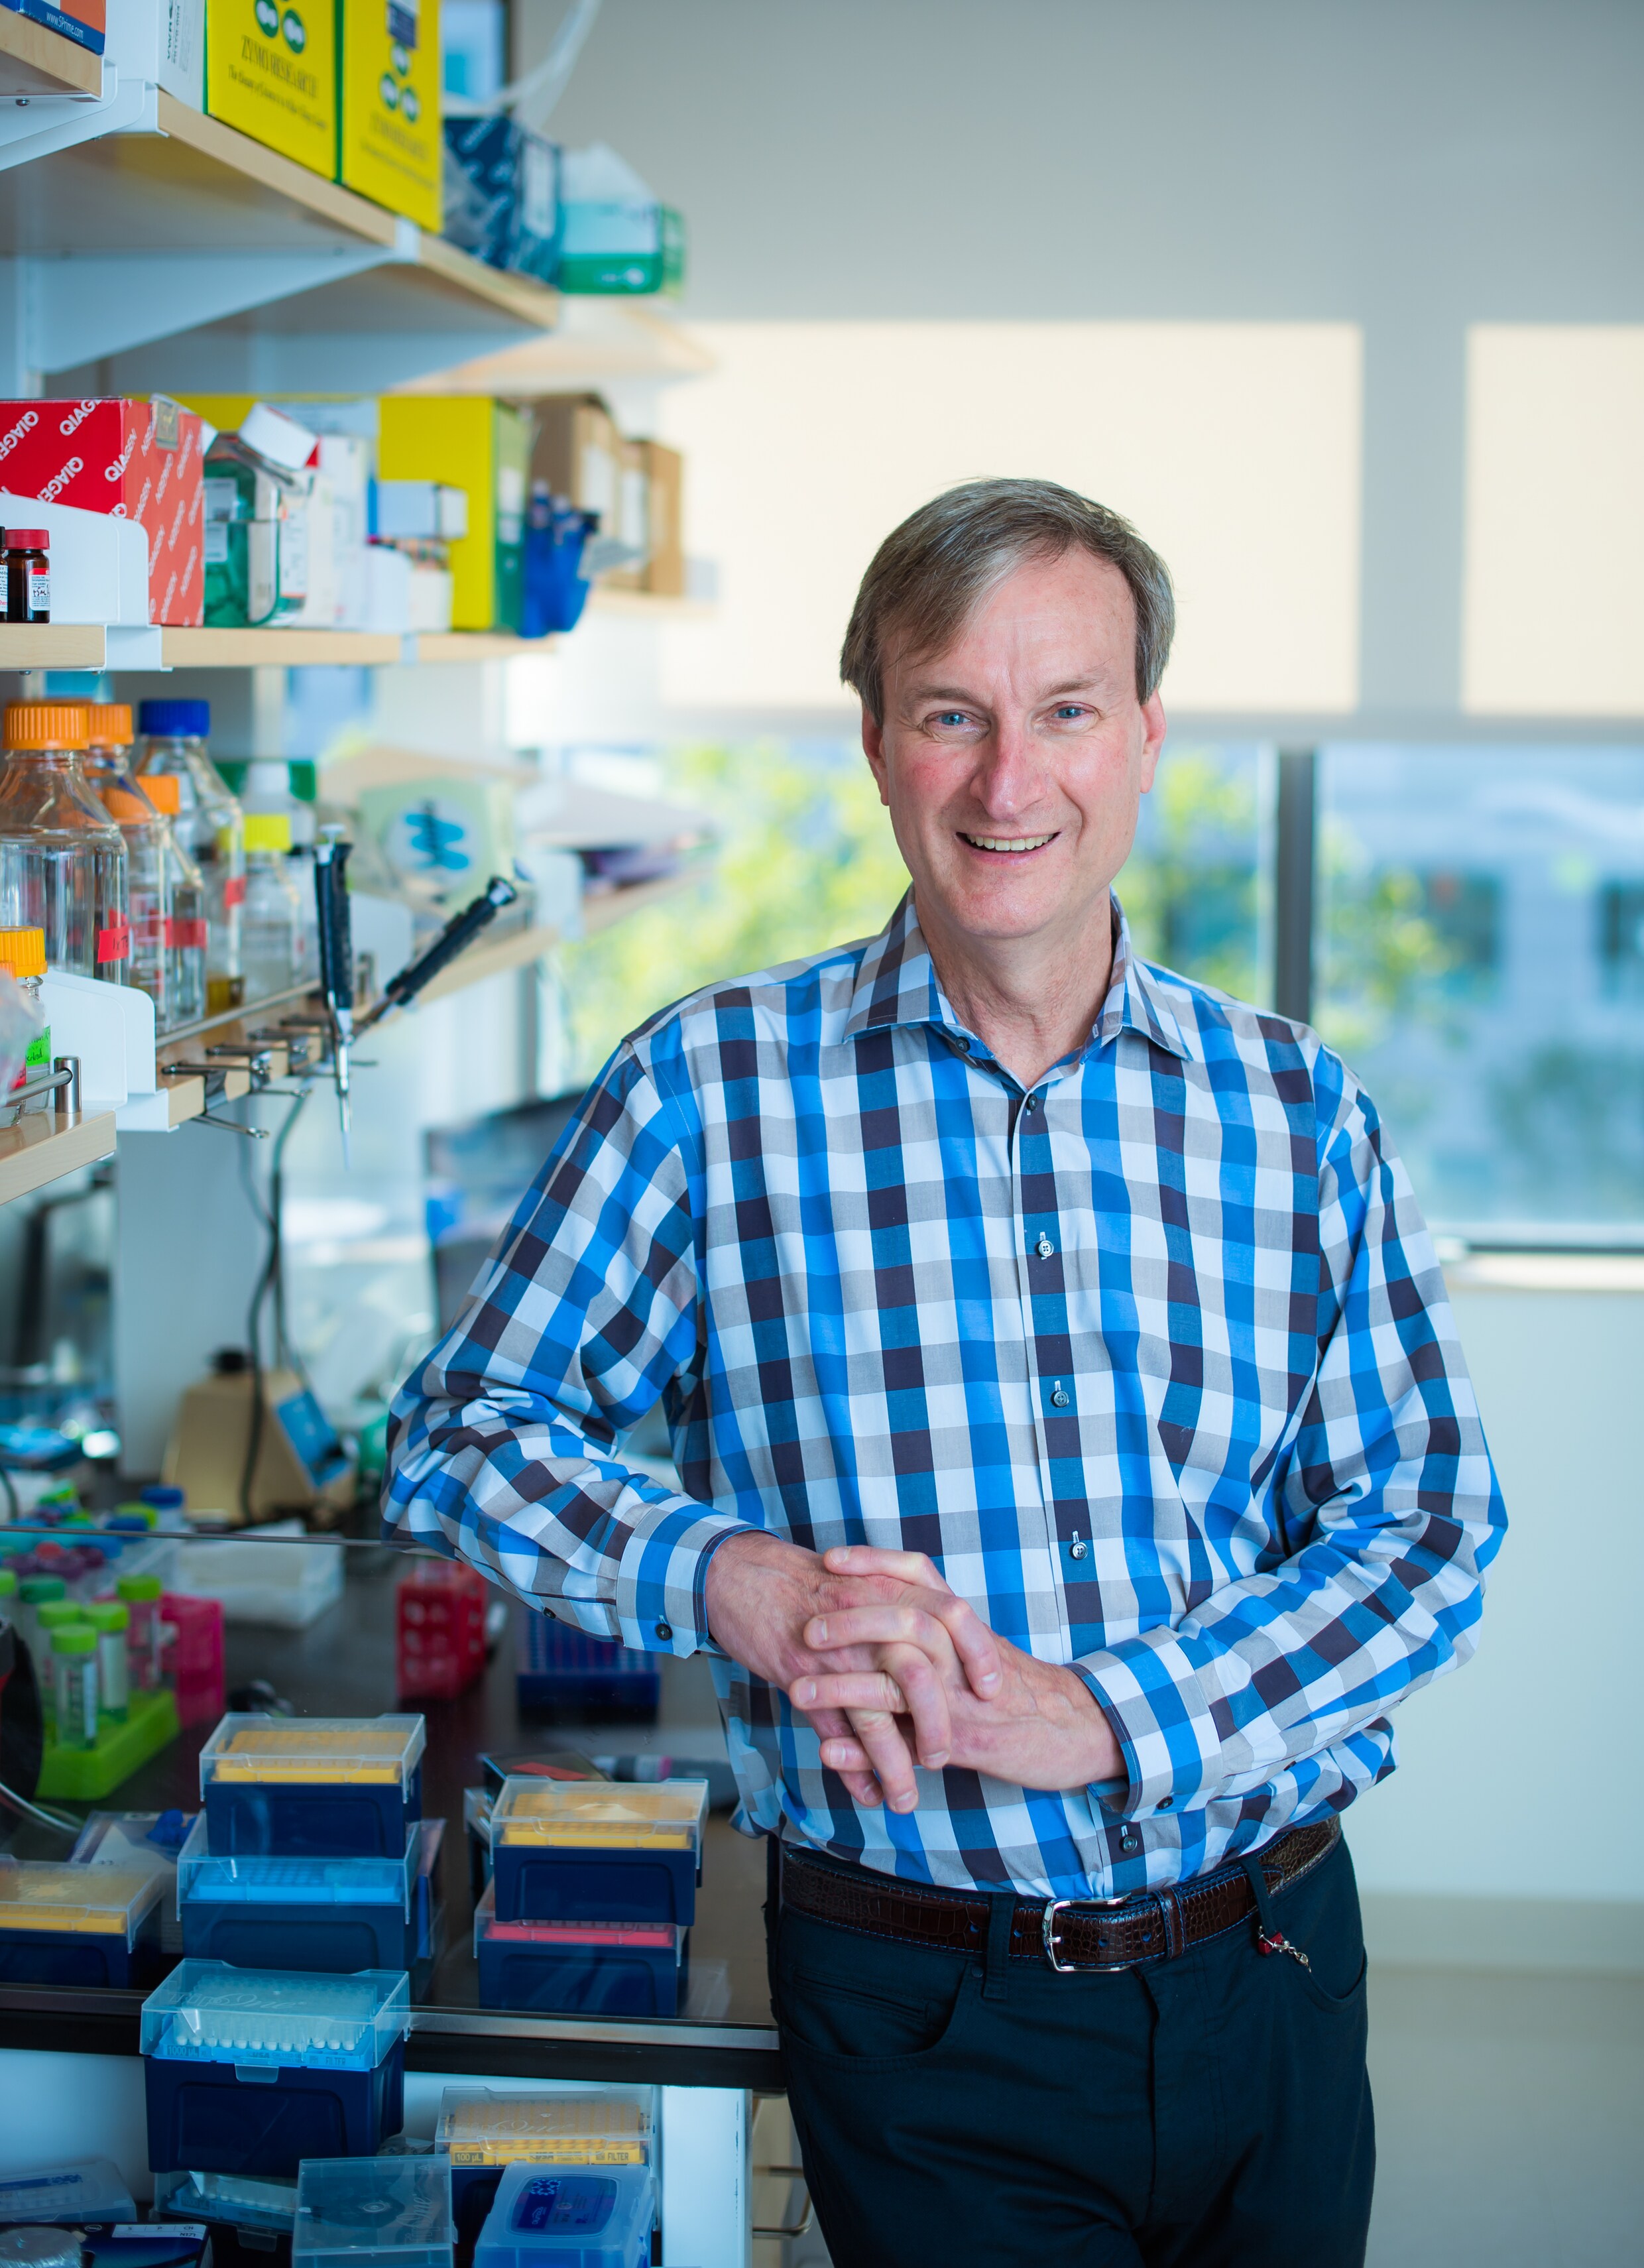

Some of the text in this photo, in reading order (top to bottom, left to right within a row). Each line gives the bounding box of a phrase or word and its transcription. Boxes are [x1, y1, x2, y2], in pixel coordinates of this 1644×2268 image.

[46, 11, 84, 40] www.5Prime.com
[60, 399, 102, 436] QIAG
[0, 411, 39, 461] QIAGE
[168, 2046, 186, 2056] 1000
[608, 2152, 629, 2161] FILTER
